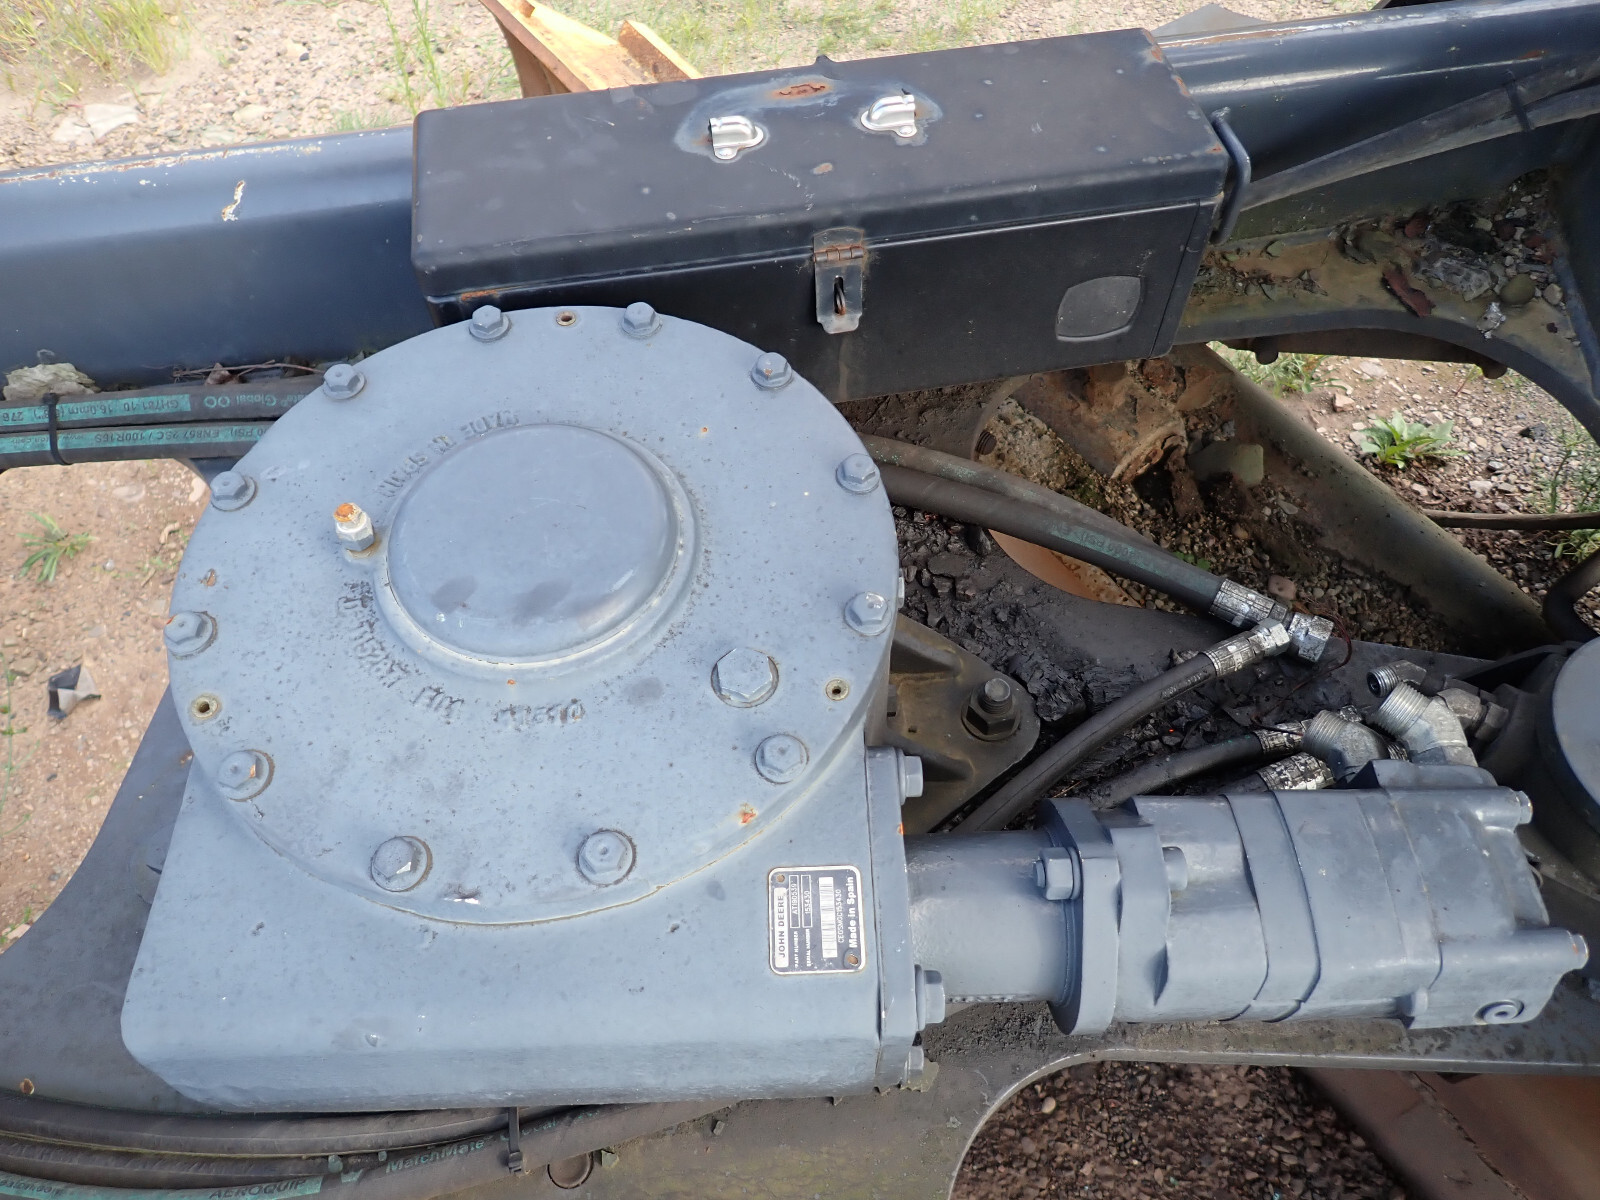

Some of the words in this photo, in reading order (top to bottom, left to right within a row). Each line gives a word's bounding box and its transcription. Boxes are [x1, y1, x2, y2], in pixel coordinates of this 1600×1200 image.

[236, 395, 277, 407] Global
[3, 411, 24, 422] 276
[803, 890, 811, 914] 153430
[846, 876, 856, 905] Spain
[777, 895, 785, 927] DEERE
[847, 908, 856, 918] in
[778, 931, 786, 958] JOHN
[847, 920, 858, 948] Made
[209, 1178, 307, 1199] AEROQUIP
